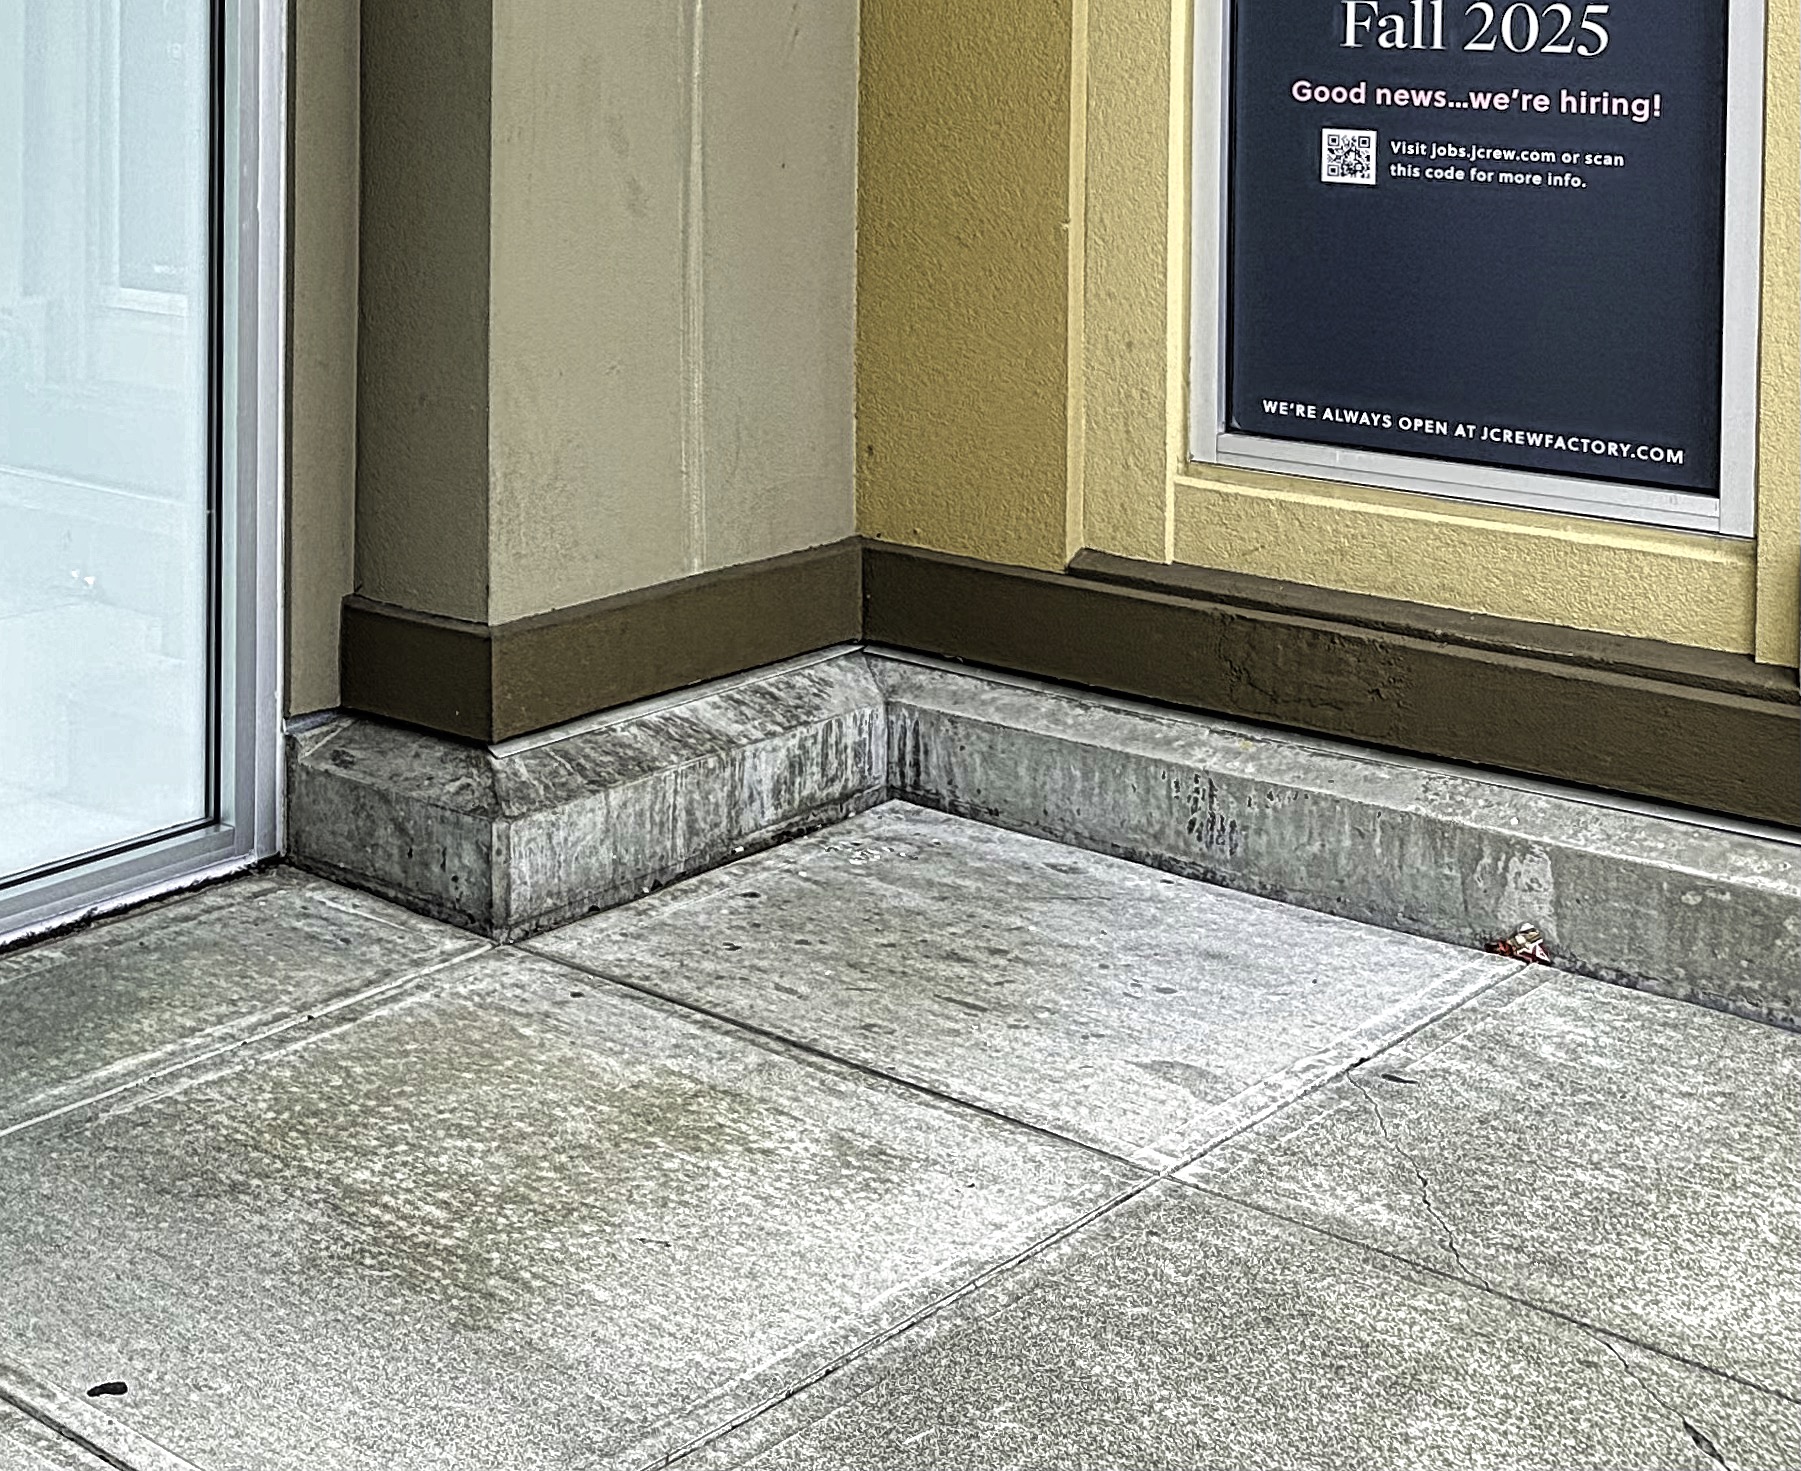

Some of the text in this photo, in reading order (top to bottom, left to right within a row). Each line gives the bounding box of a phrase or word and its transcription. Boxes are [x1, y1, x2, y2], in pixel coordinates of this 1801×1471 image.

[1463, 1, 1610, 57] 2025
[1291, 80, 1367, 105] Good
[1560, 89, 1662, 123] hiring!
[1390, 140, 1625, 167] Visit jobs.jcrew.com or scan
[1389, 163, 1587, 188] this code for more info.
[1262, 399, 1685, 465] WE'RE ALWAYS OPEN AT JCREWFACTORY.COM
